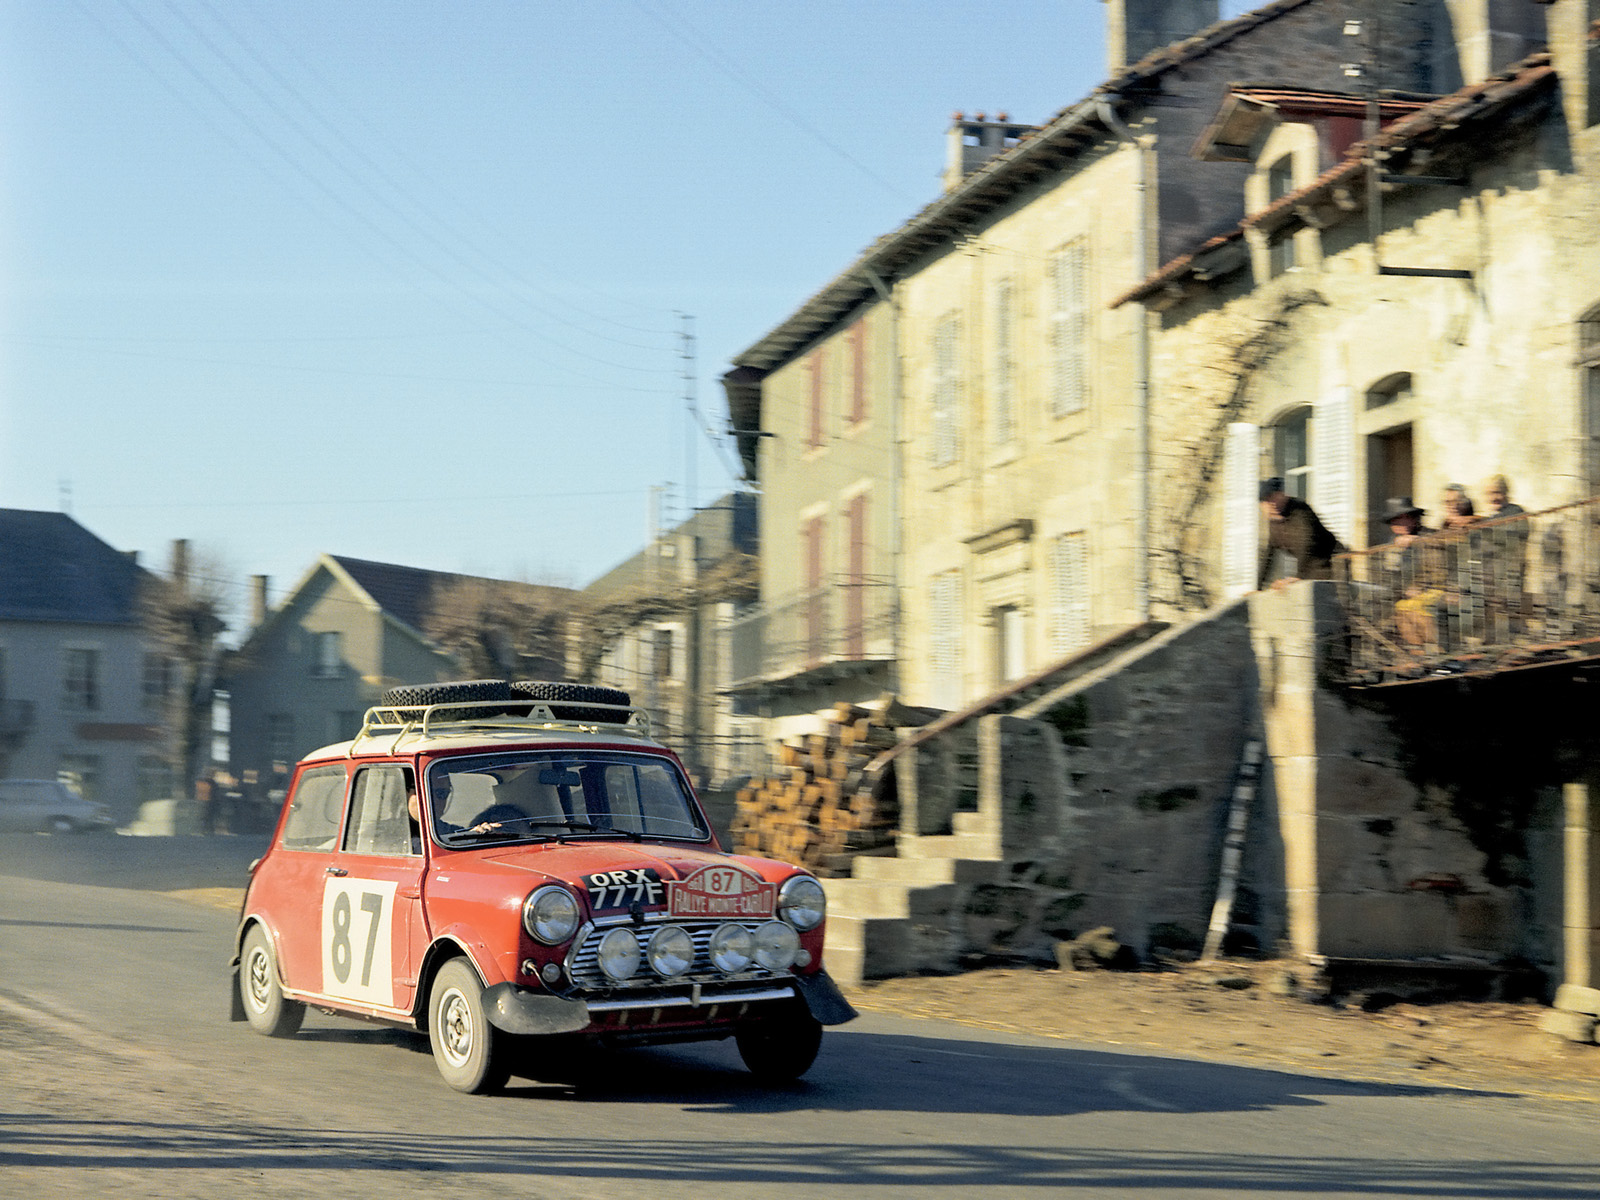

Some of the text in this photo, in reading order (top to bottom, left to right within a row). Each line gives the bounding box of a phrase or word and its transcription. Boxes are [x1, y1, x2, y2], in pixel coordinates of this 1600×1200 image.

[589, 869, 653, 887] ORX
[711, 871, 735, 892] 87
[588, 882, 663, 910] 777F
[674, 888, 707, 913] RALLYE
[331, 891, 384, 987] 87
